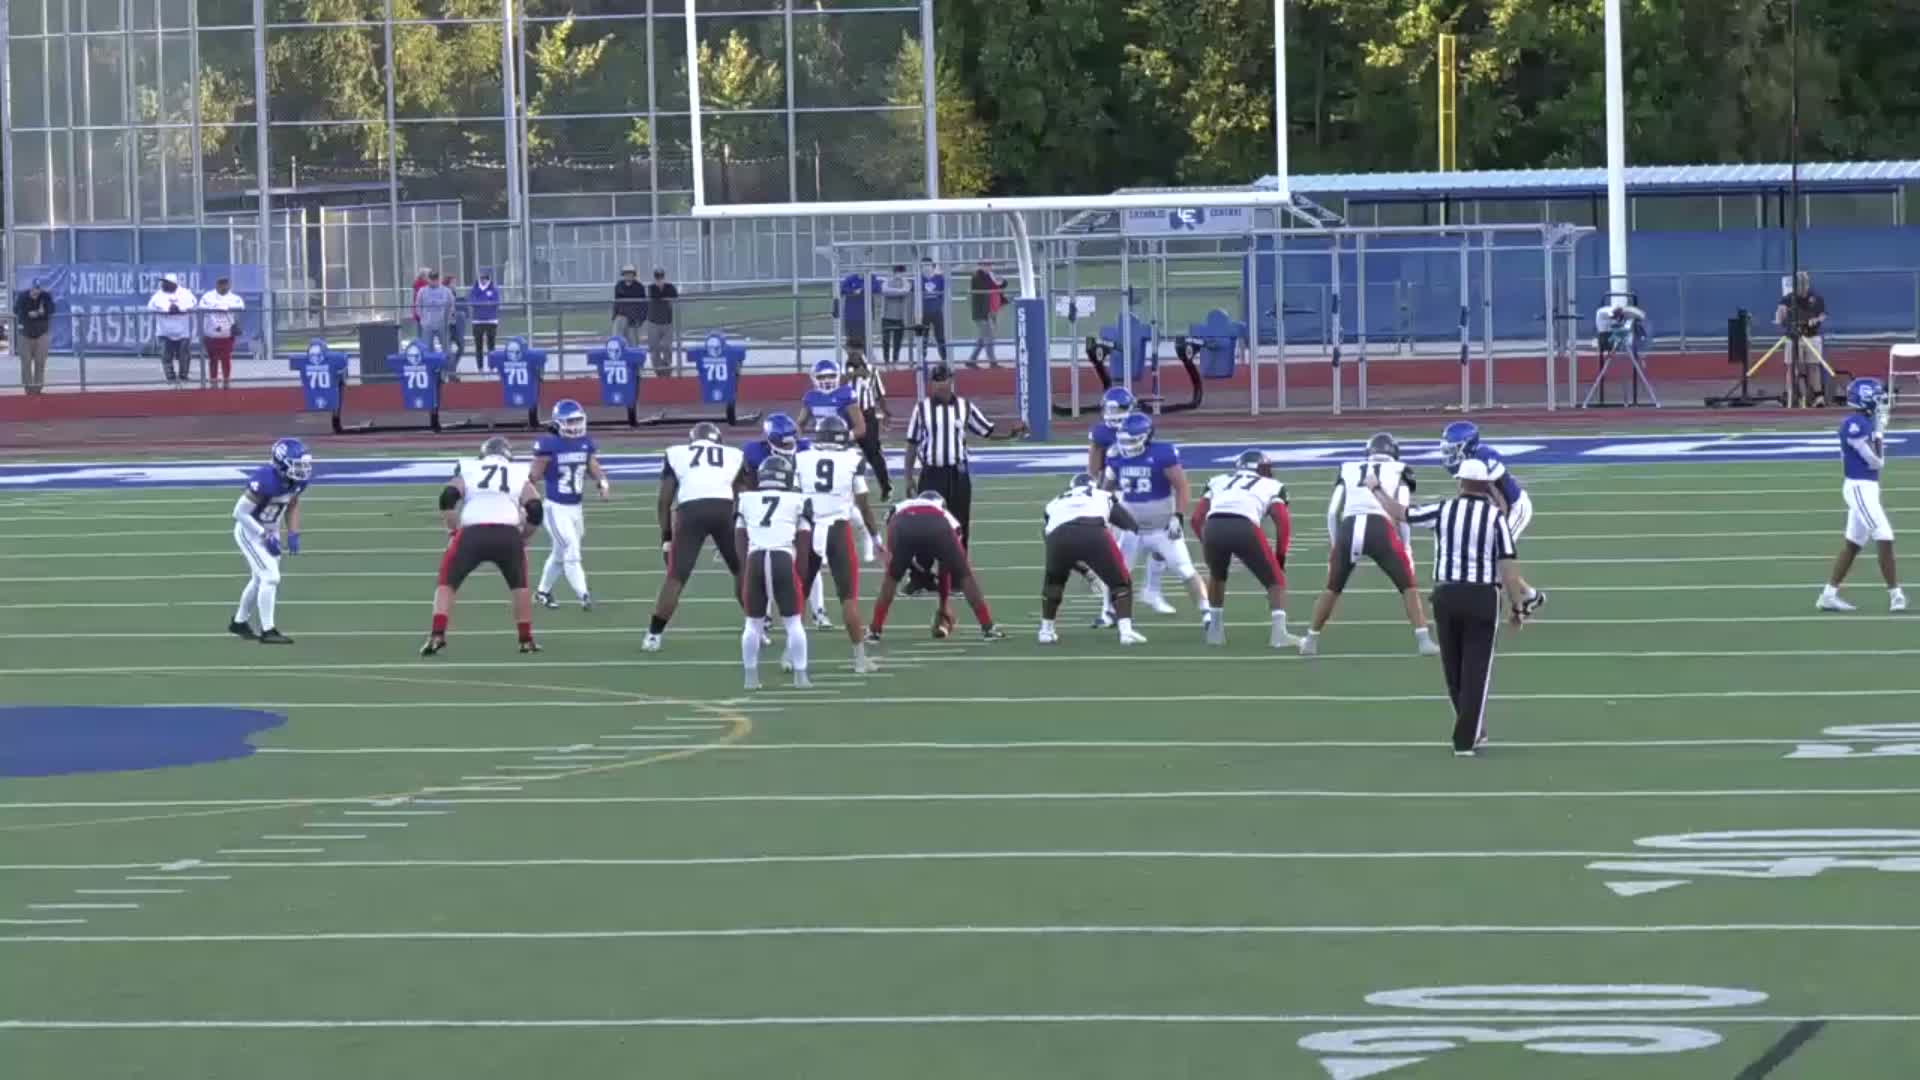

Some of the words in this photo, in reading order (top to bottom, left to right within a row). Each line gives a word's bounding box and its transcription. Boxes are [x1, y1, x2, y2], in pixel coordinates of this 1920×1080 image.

[69, 271, 136, 295] CATHOLIC
[138, 271, 205, 294] CERAL
[70, 304, 201, 344] BASEBL
[305, 371, 331, 389] 70
[404, 371, 429, 389] 70
[504, 367, 529, 385] 70
[604, 366, 628, 385] 70
[704, 363, 728, 381] 70
[688, 445, 724, 468] 70
[477, 463, 511, 493] 71
[814, 458, 835, 493] 9
[759, 496, 781, 528] 7
